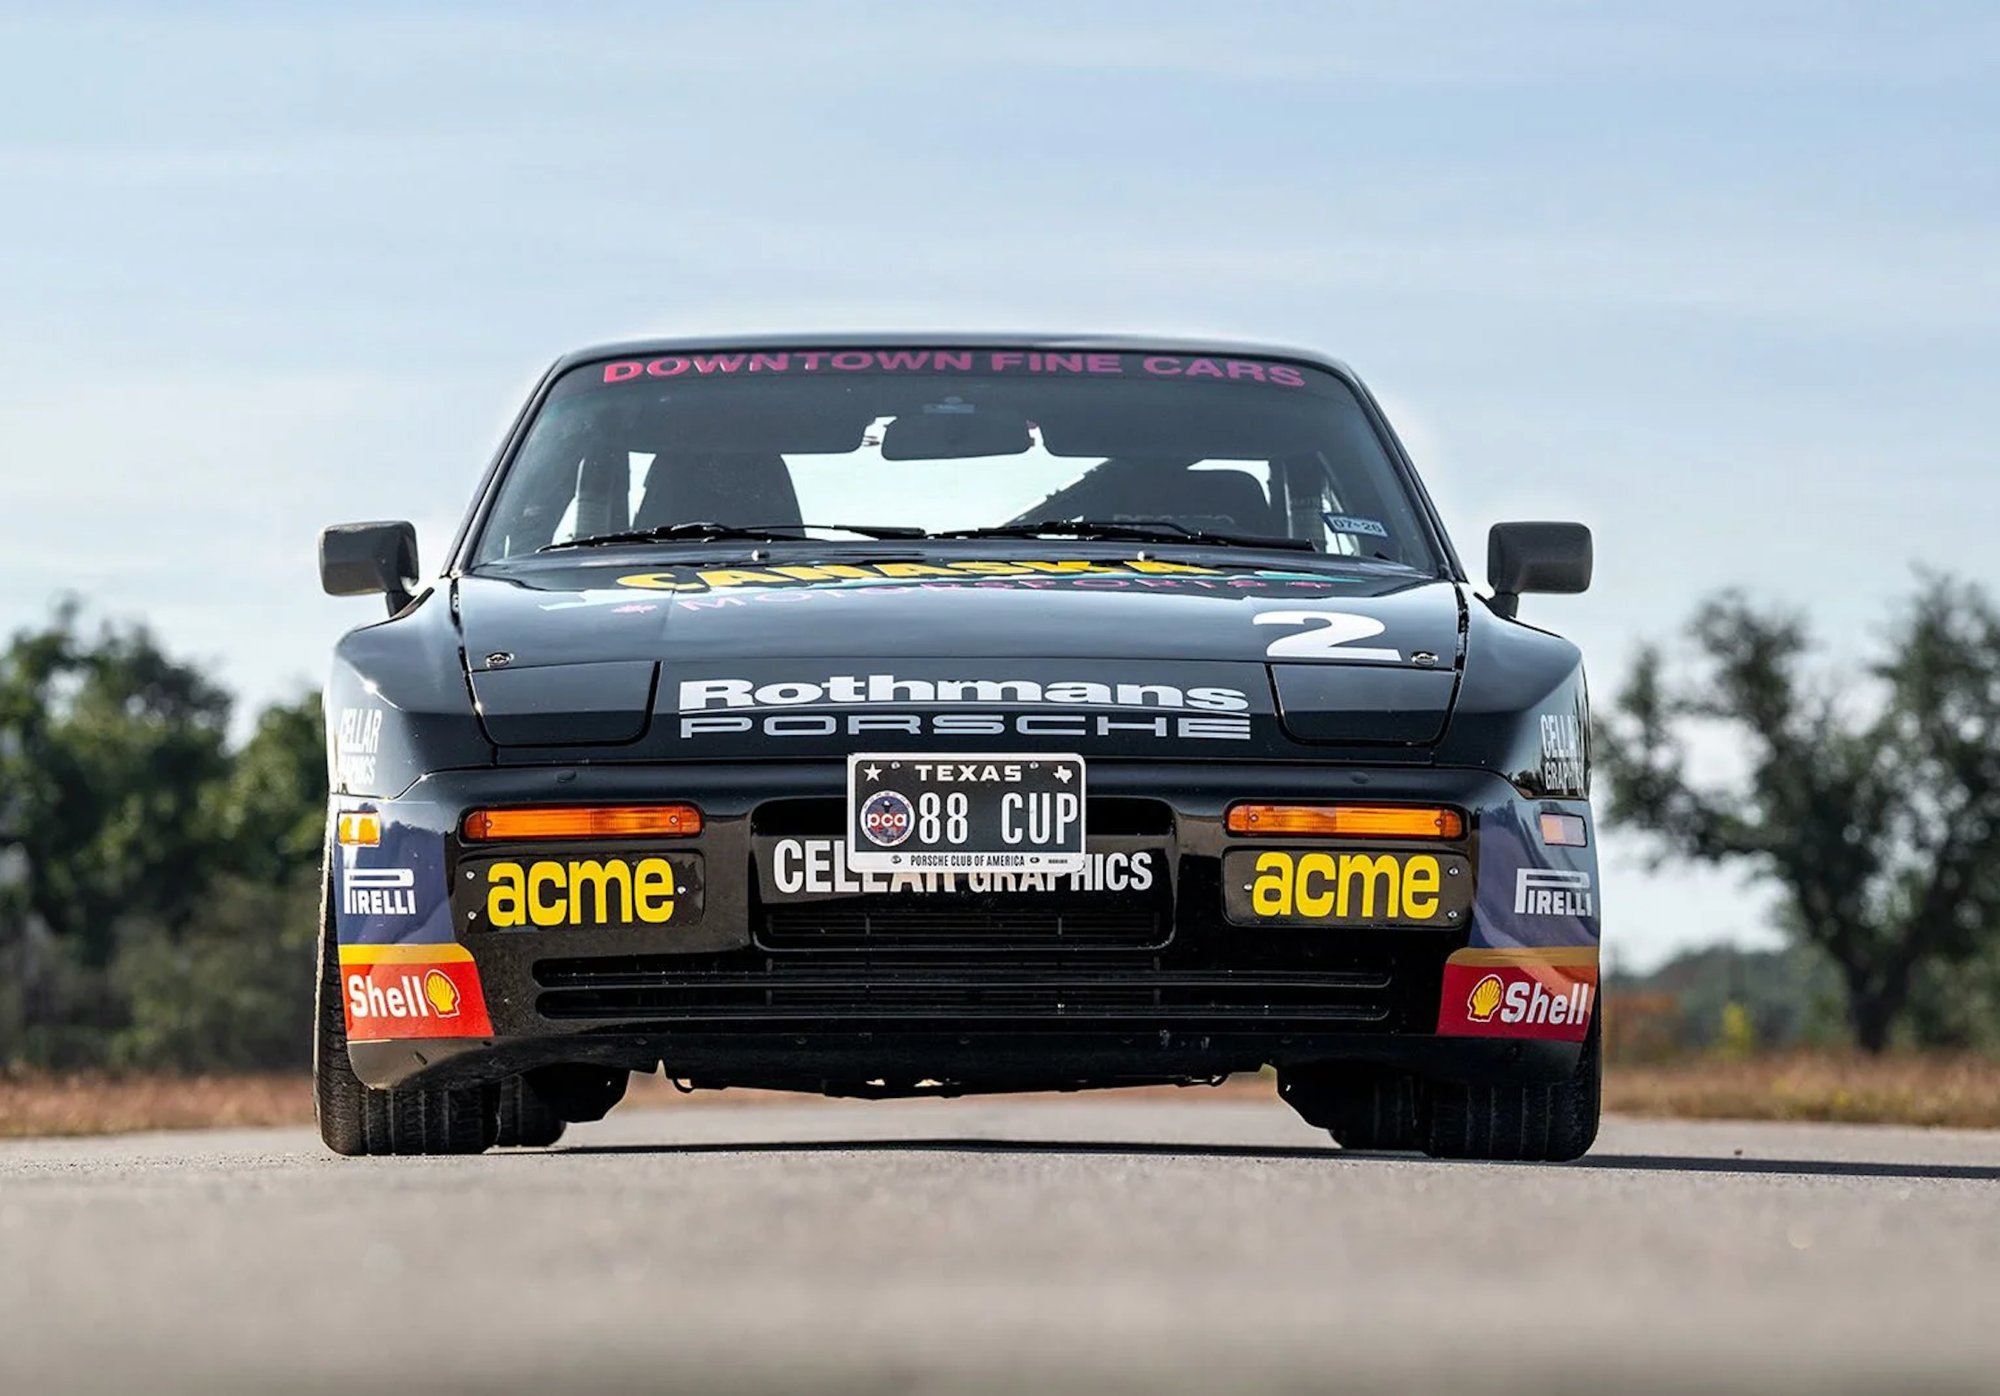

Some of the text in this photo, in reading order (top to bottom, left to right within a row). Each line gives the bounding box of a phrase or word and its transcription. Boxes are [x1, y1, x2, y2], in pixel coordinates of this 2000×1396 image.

[603, 351, 1306, 387] DOWNTOWN FINE CARS
[1252, 610, 1401, 660] 2
[679, 674, 1250, 711] Rothmans
[679, 714, 1251, 739] PORSCHE
[914, 764, 1022, 782] TEXAS
[866, 812, 908, 829] pca
[918, 791, 1079, 845] 88 CUP
[910, 854, 1025, 867] PORSCHE CLUB OF AMERICA
[343, 867, 417, 915] PIRELLI
[486, 857, 676, 928] acme
[1251, 851, 1441, 920] acme
[1513, 867, 1594, 917] PIRELLI
[347, 974, 430, 1019] Shell
[1500, 980, 1590, 1026] Shell
